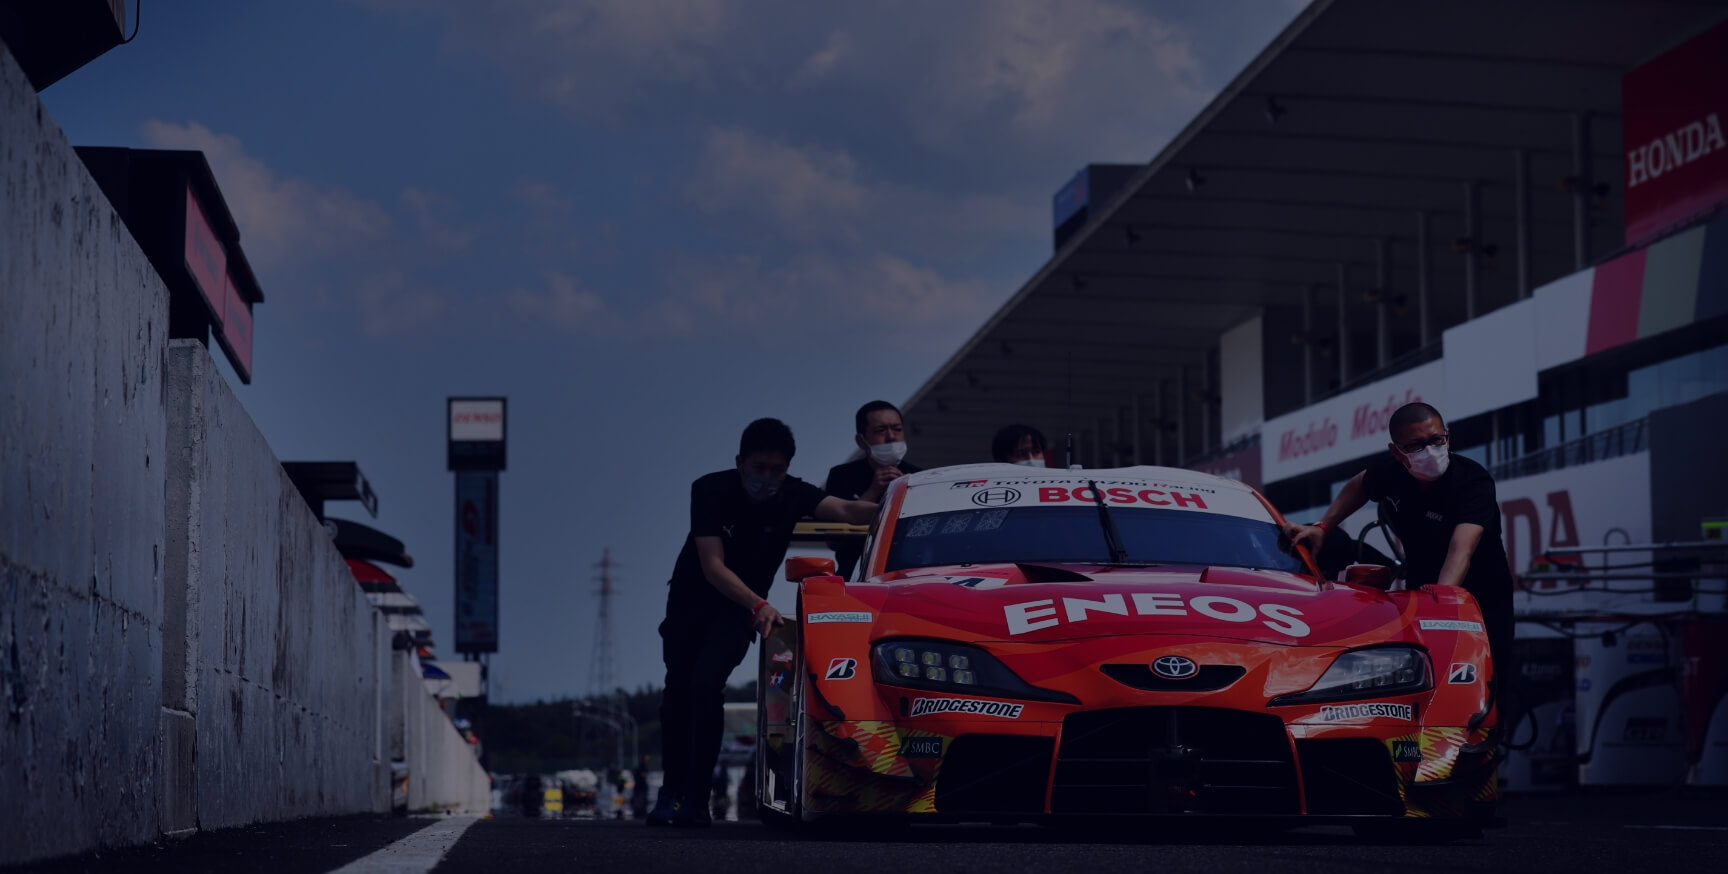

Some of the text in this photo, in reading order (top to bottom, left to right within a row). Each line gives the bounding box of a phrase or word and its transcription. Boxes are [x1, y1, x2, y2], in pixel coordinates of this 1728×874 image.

[1627, 111, 1727, 189] HONDA
[1279, 417, 1339, 463] Modulo
[1039, 486, 1208, 509] BOSCH
[1003, 592, 1312, 638] ENEOS
[912, 699, 1023, 717] BRIDGESTONE
[1322, 704, 1411, 721] BRIDGESTONE
[910, 742, 940, 754] SMBC
